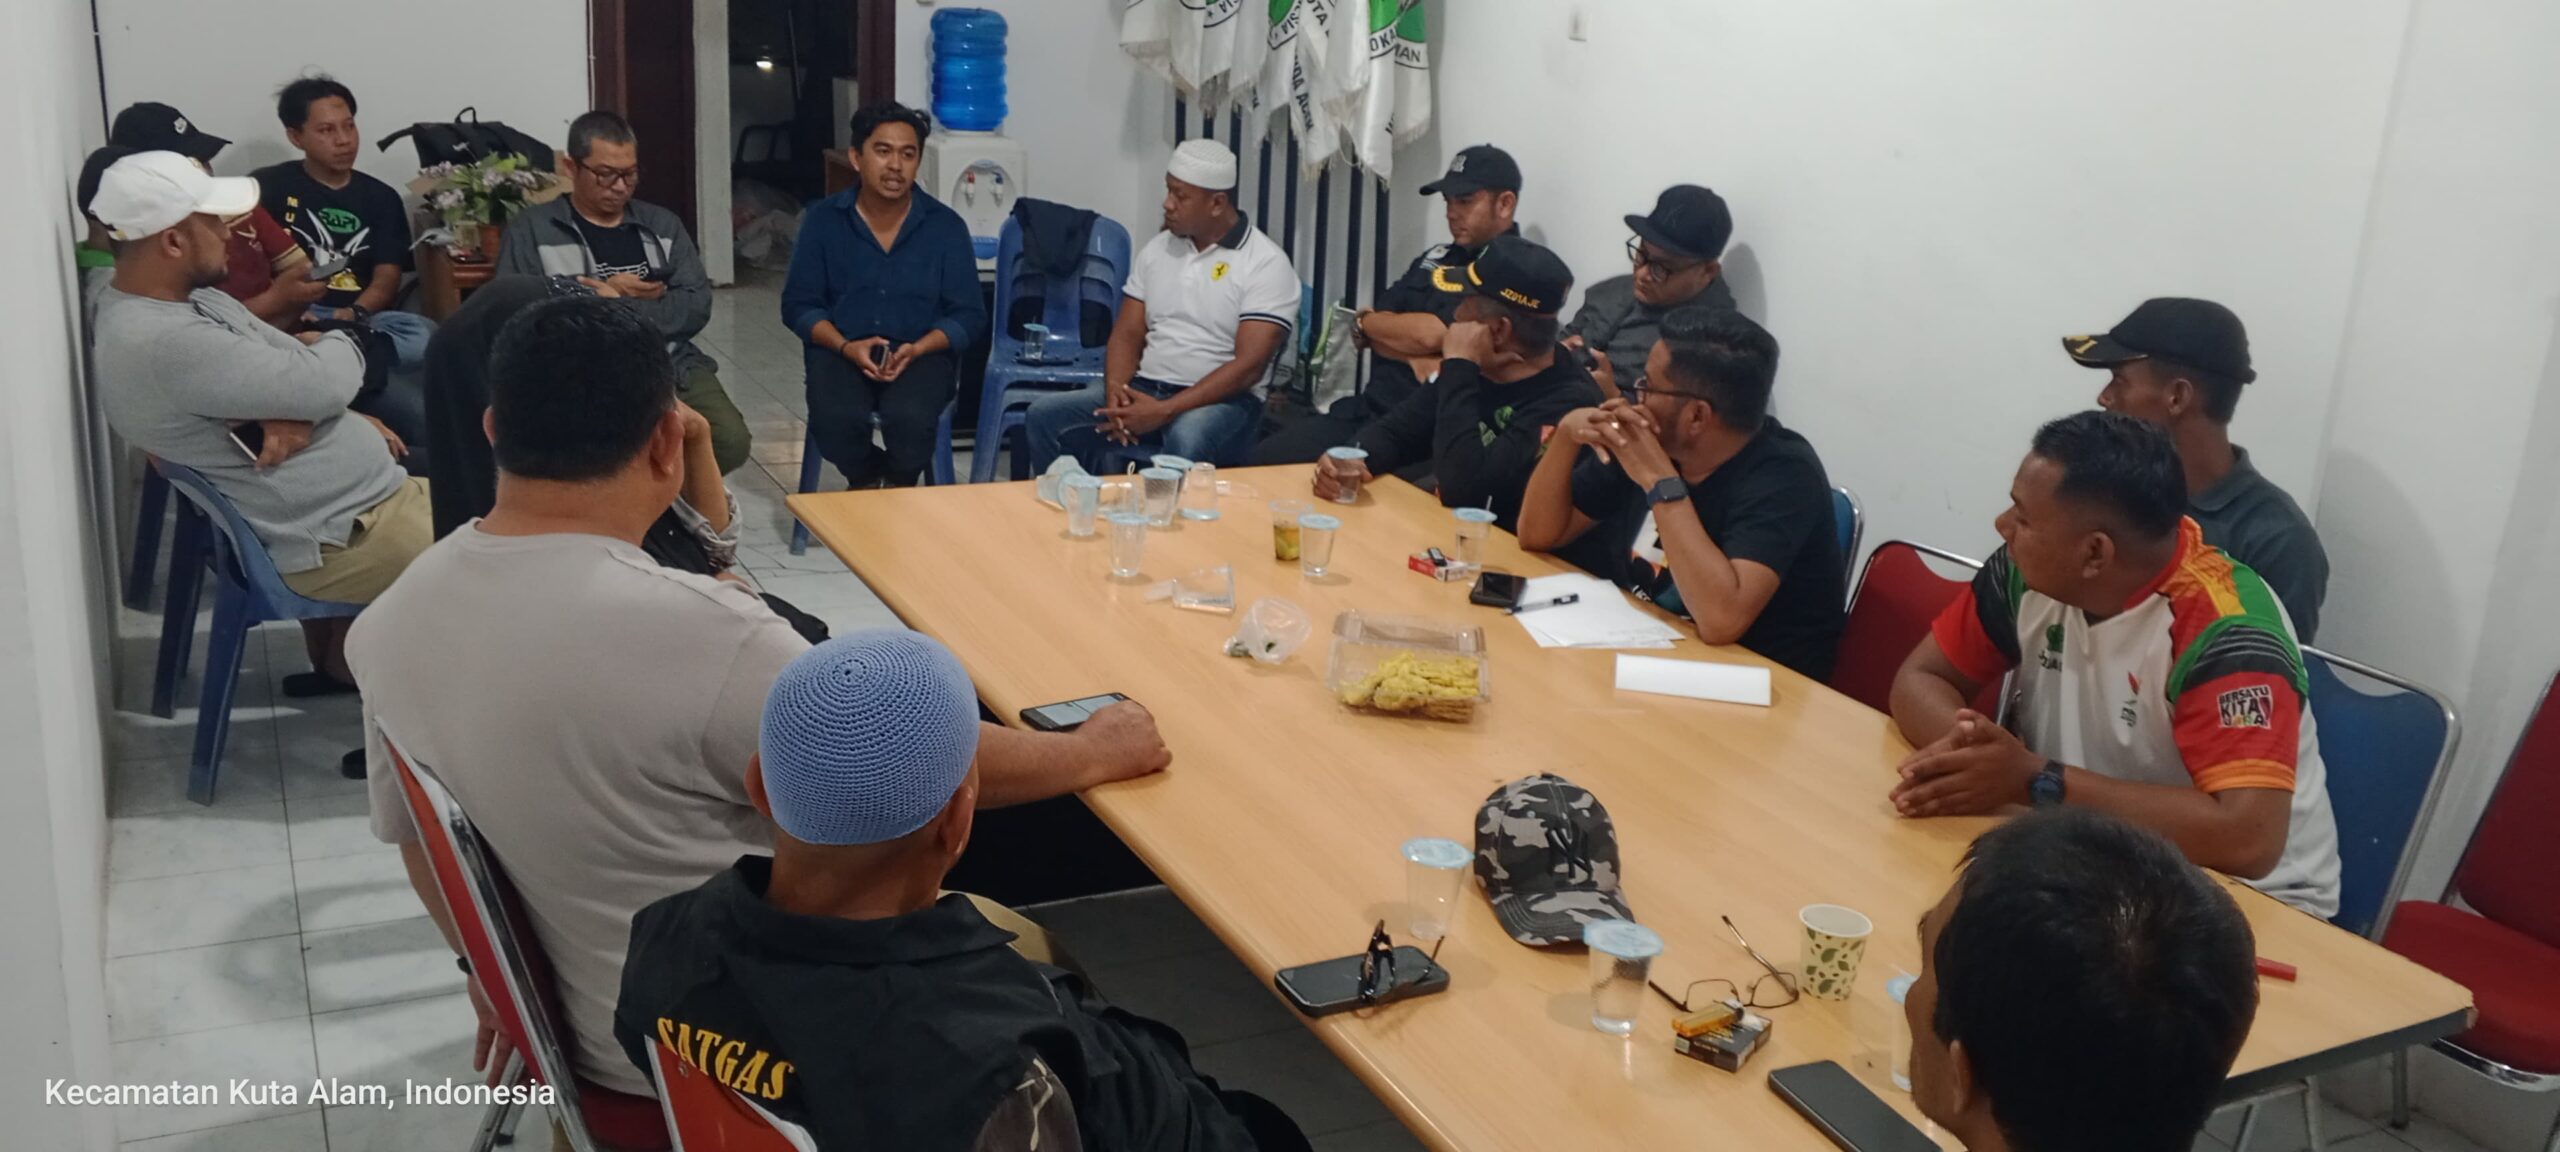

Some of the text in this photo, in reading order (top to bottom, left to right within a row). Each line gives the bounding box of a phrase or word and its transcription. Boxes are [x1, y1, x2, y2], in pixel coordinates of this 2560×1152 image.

[2219, 686, 2270, 704] BERSATU
[2221, 699, 2261, 719] KITA
[657, 1017, 795, 1100] SATGAS
